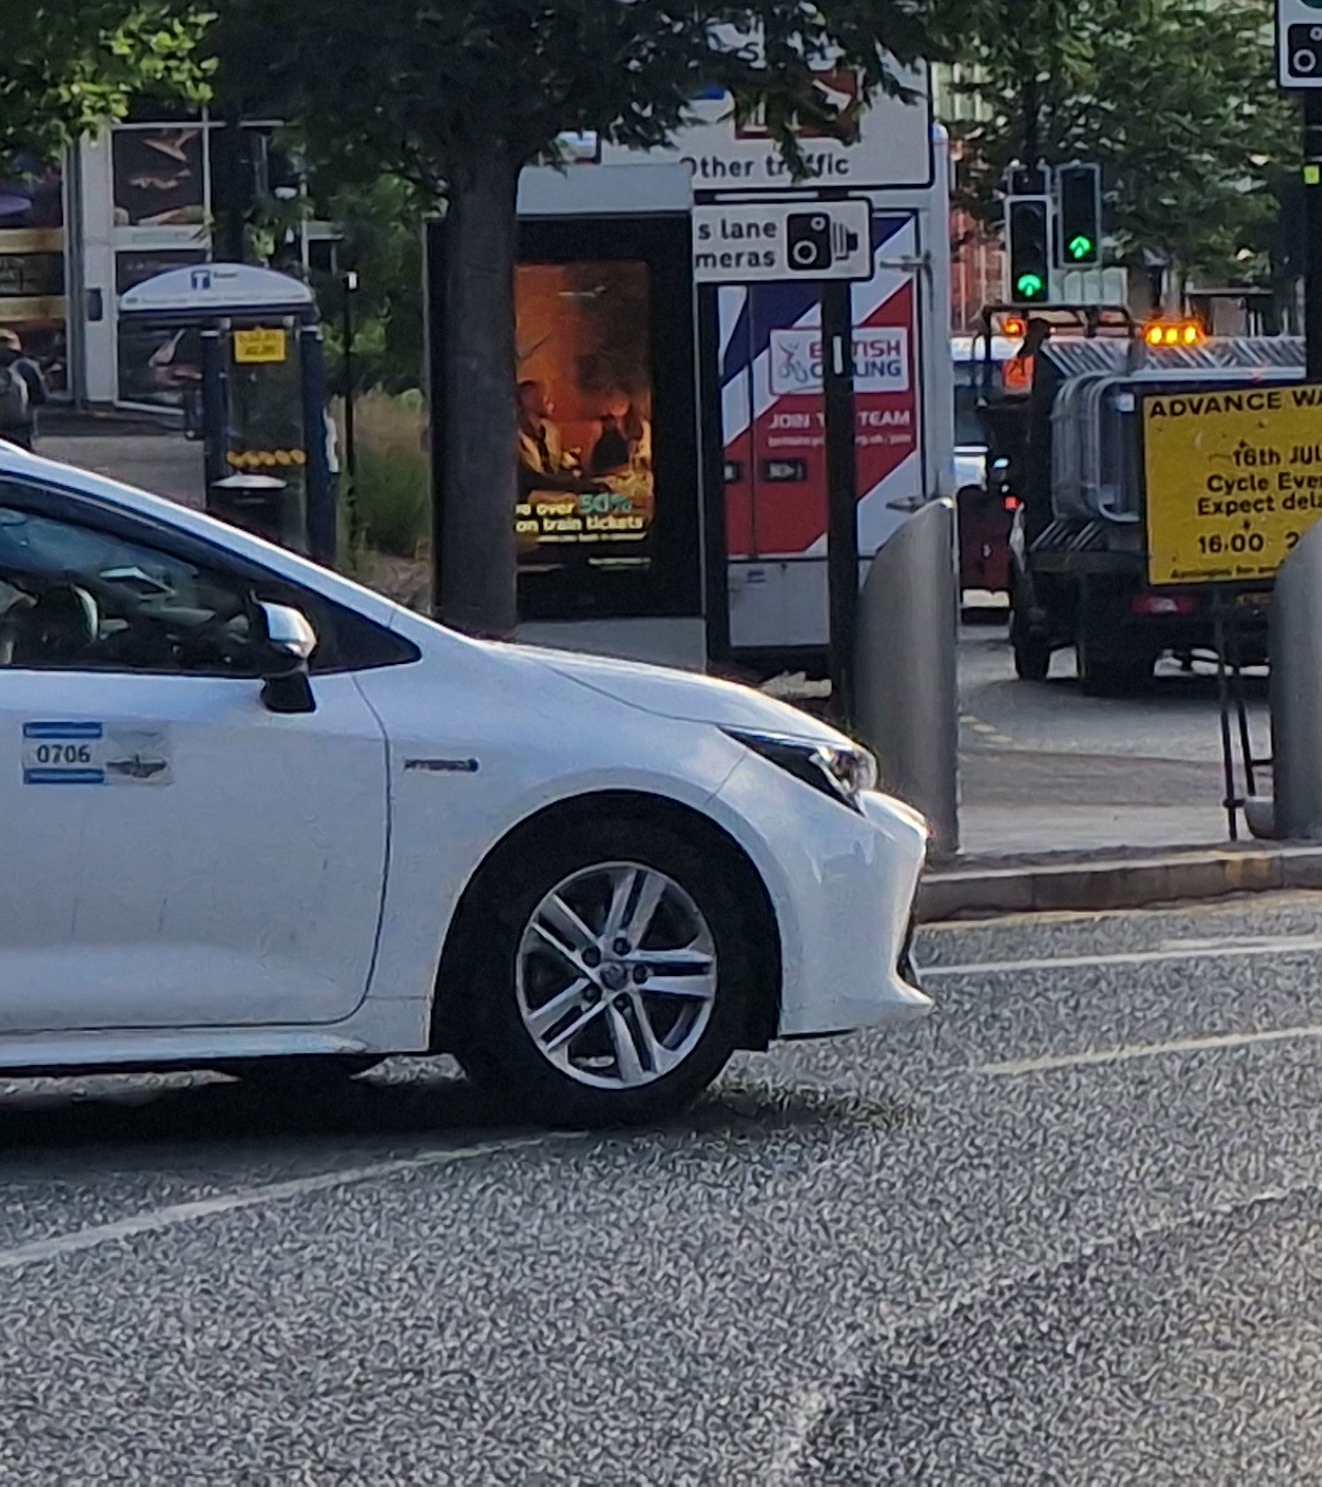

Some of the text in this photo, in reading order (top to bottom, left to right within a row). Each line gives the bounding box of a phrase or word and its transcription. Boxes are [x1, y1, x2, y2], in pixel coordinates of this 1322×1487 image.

[680, 153, 850, 178] Other trffic
[721, 218, 778, 240] lane
[695, 250, 776, 269] meras
[809, 340, 901, 359] BTISH
[809, 359, 903, 378] CLING
[1149, 392, 1282, 417] ADVANCE
[1207, 474, 1270, 496] Cycle
[1197, 496, 1276, 517] Expect
[37, 744, 91, 764] 0706
